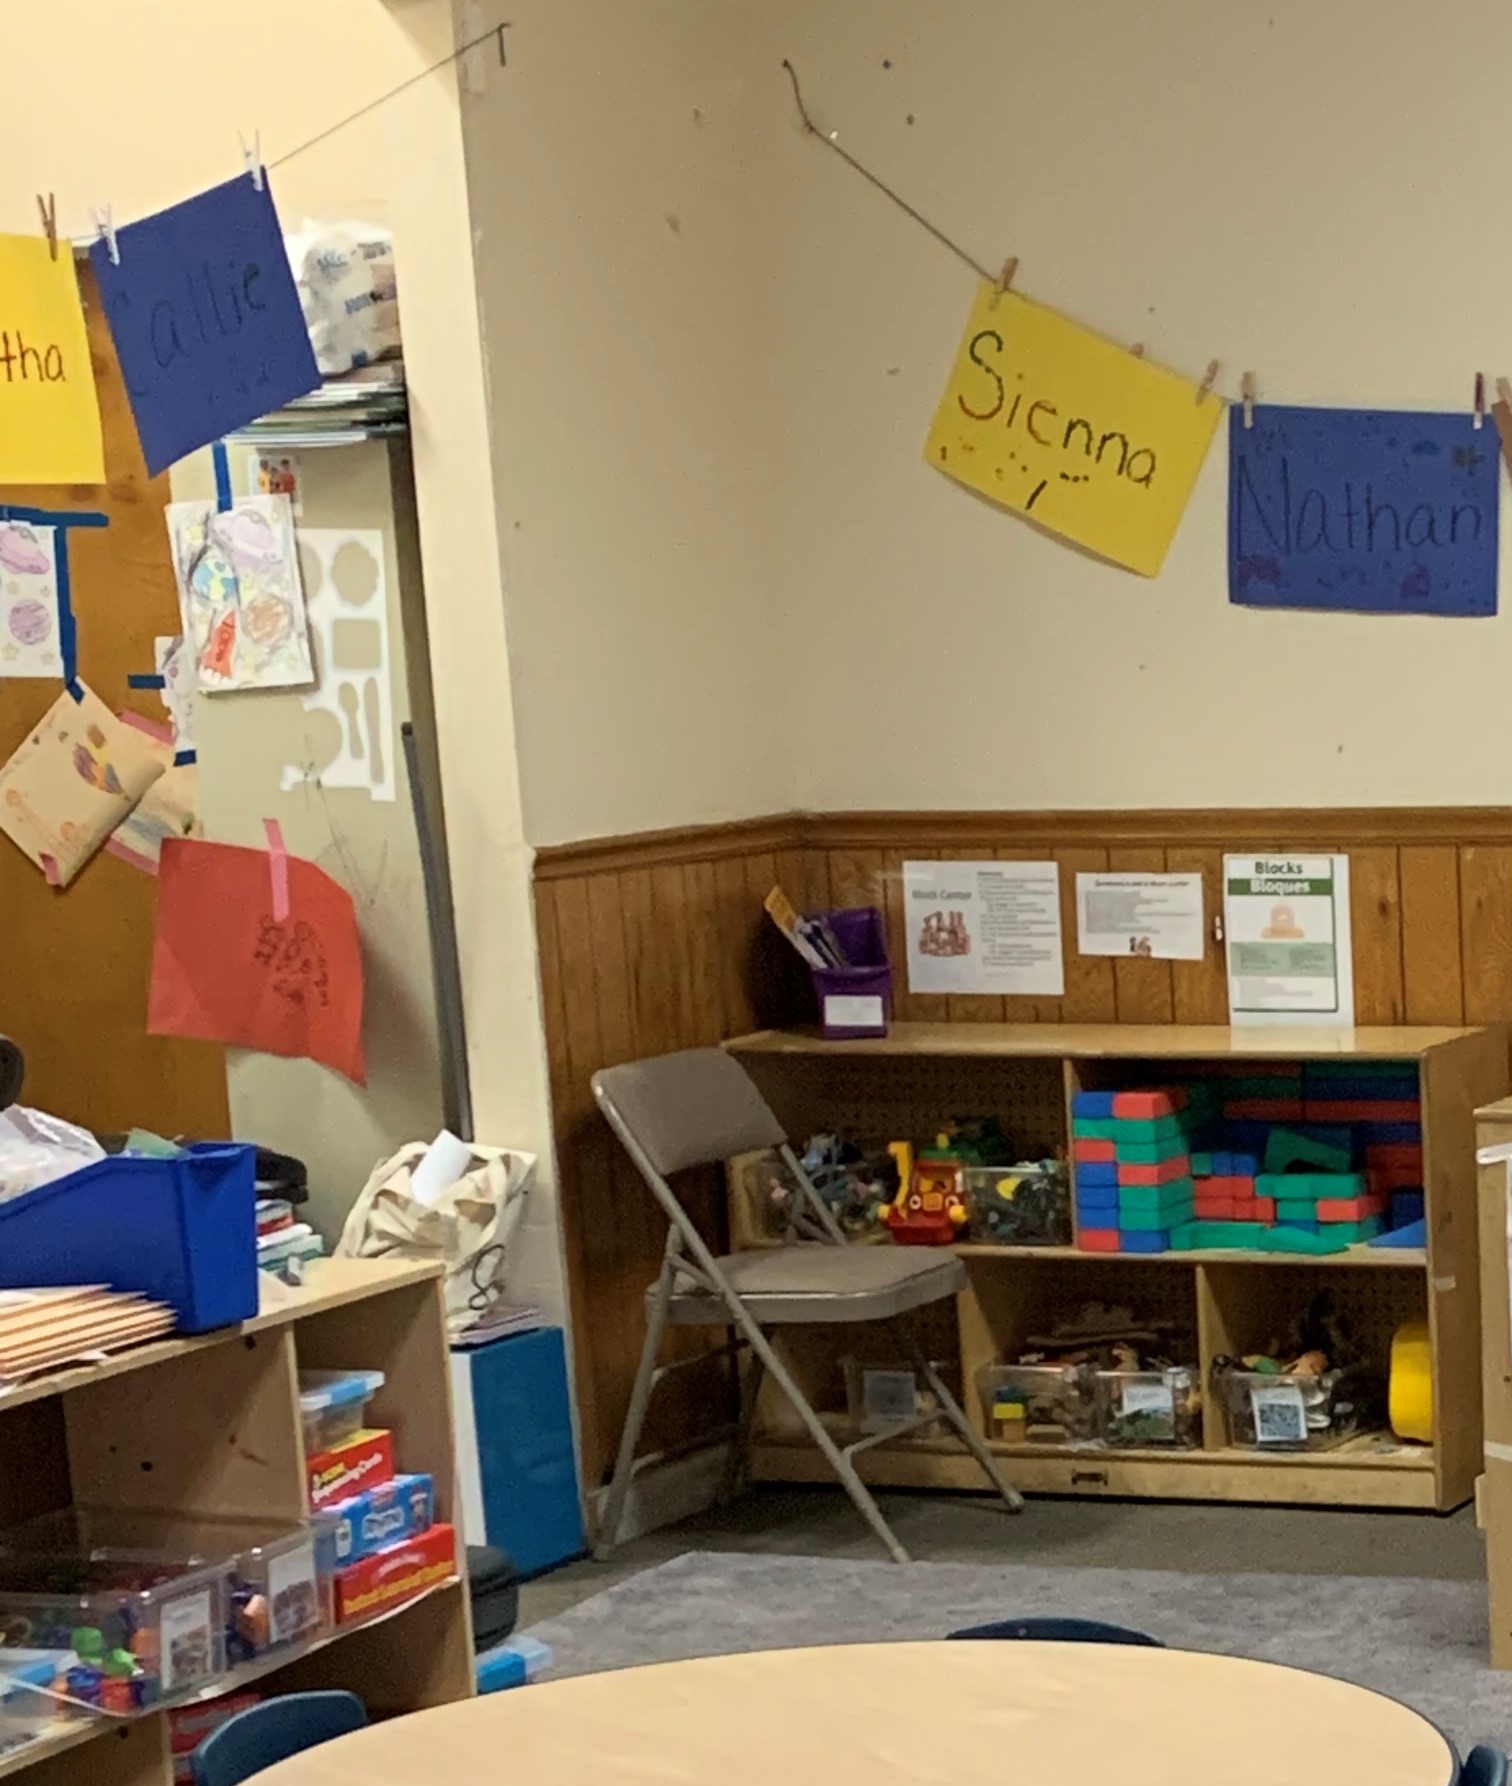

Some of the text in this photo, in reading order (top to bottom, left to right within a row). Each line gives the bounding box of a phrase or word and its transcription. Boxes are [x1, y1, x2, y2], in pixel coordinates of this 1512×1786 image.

[958, 331, 1156, 488] Sienna
[1237, 454, 1482, 559] Nathan
[1250, 879, 1311, 897] Bloques
[1255, 861, 1304, 875] Blocks
